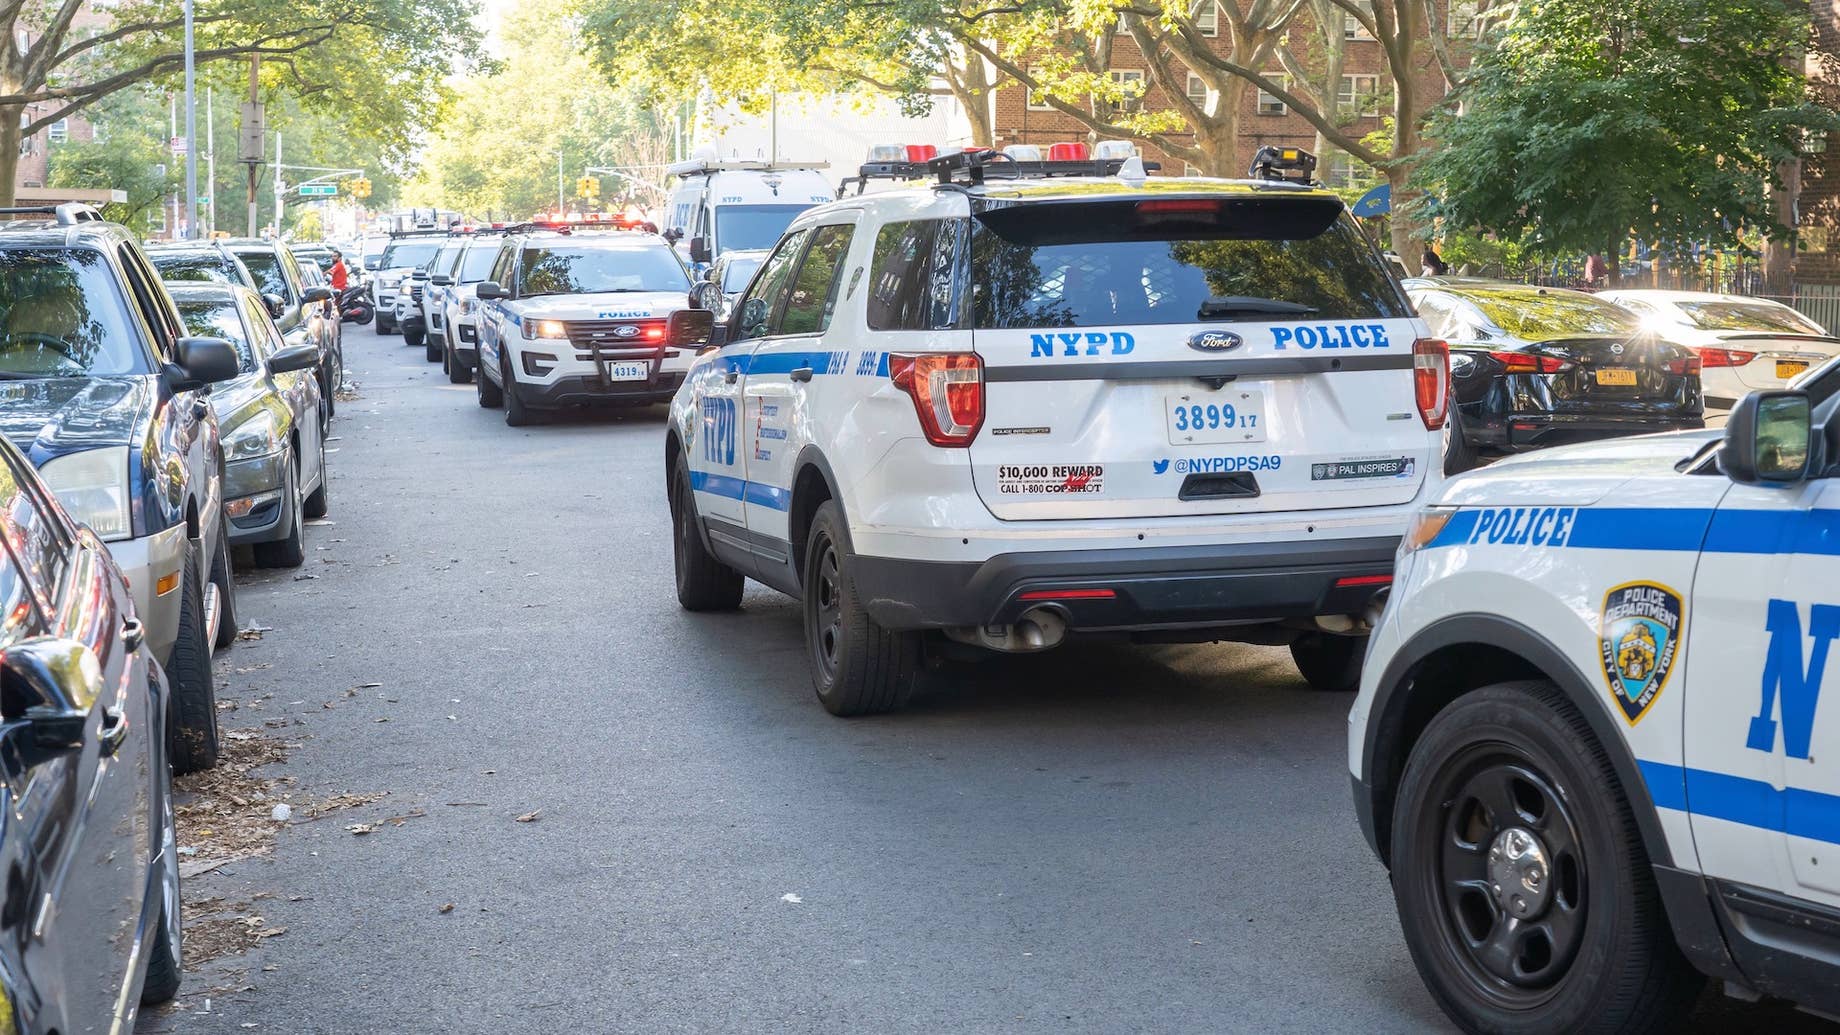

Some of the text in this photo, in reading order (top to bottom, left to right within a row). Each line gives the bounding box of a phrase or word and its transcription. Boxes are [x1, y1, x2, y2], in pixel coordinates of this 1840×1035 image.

[1030, 332, 1135, 358] NYPD
[1200, 333, 1232, 348] Ford
[1269, 324, 1390, 350] POLICE
[614, 367, 637, 377] 4319
[1174, 403, 1257, 431] 3899 17
[999, 465, 1103, 480] $10,000 REWARD
[1174, 455, 1281, 473] @NYPDPSA9
[1339, 462, 1397, 475] PAL INSPIRES
[1001, 484, 1020, 494] CALL
[1022, 484, 1044, 494] 1-800
[1469, 507, 1575, 546] POLICE
[1623, 587, 1667, 607] POLICE
[1605, 602, 1679, 630] DEPARTMENT
[1602, 640, 1625, 697] CITY OF
[1638, 639, 1677, 708] NEW YORK
